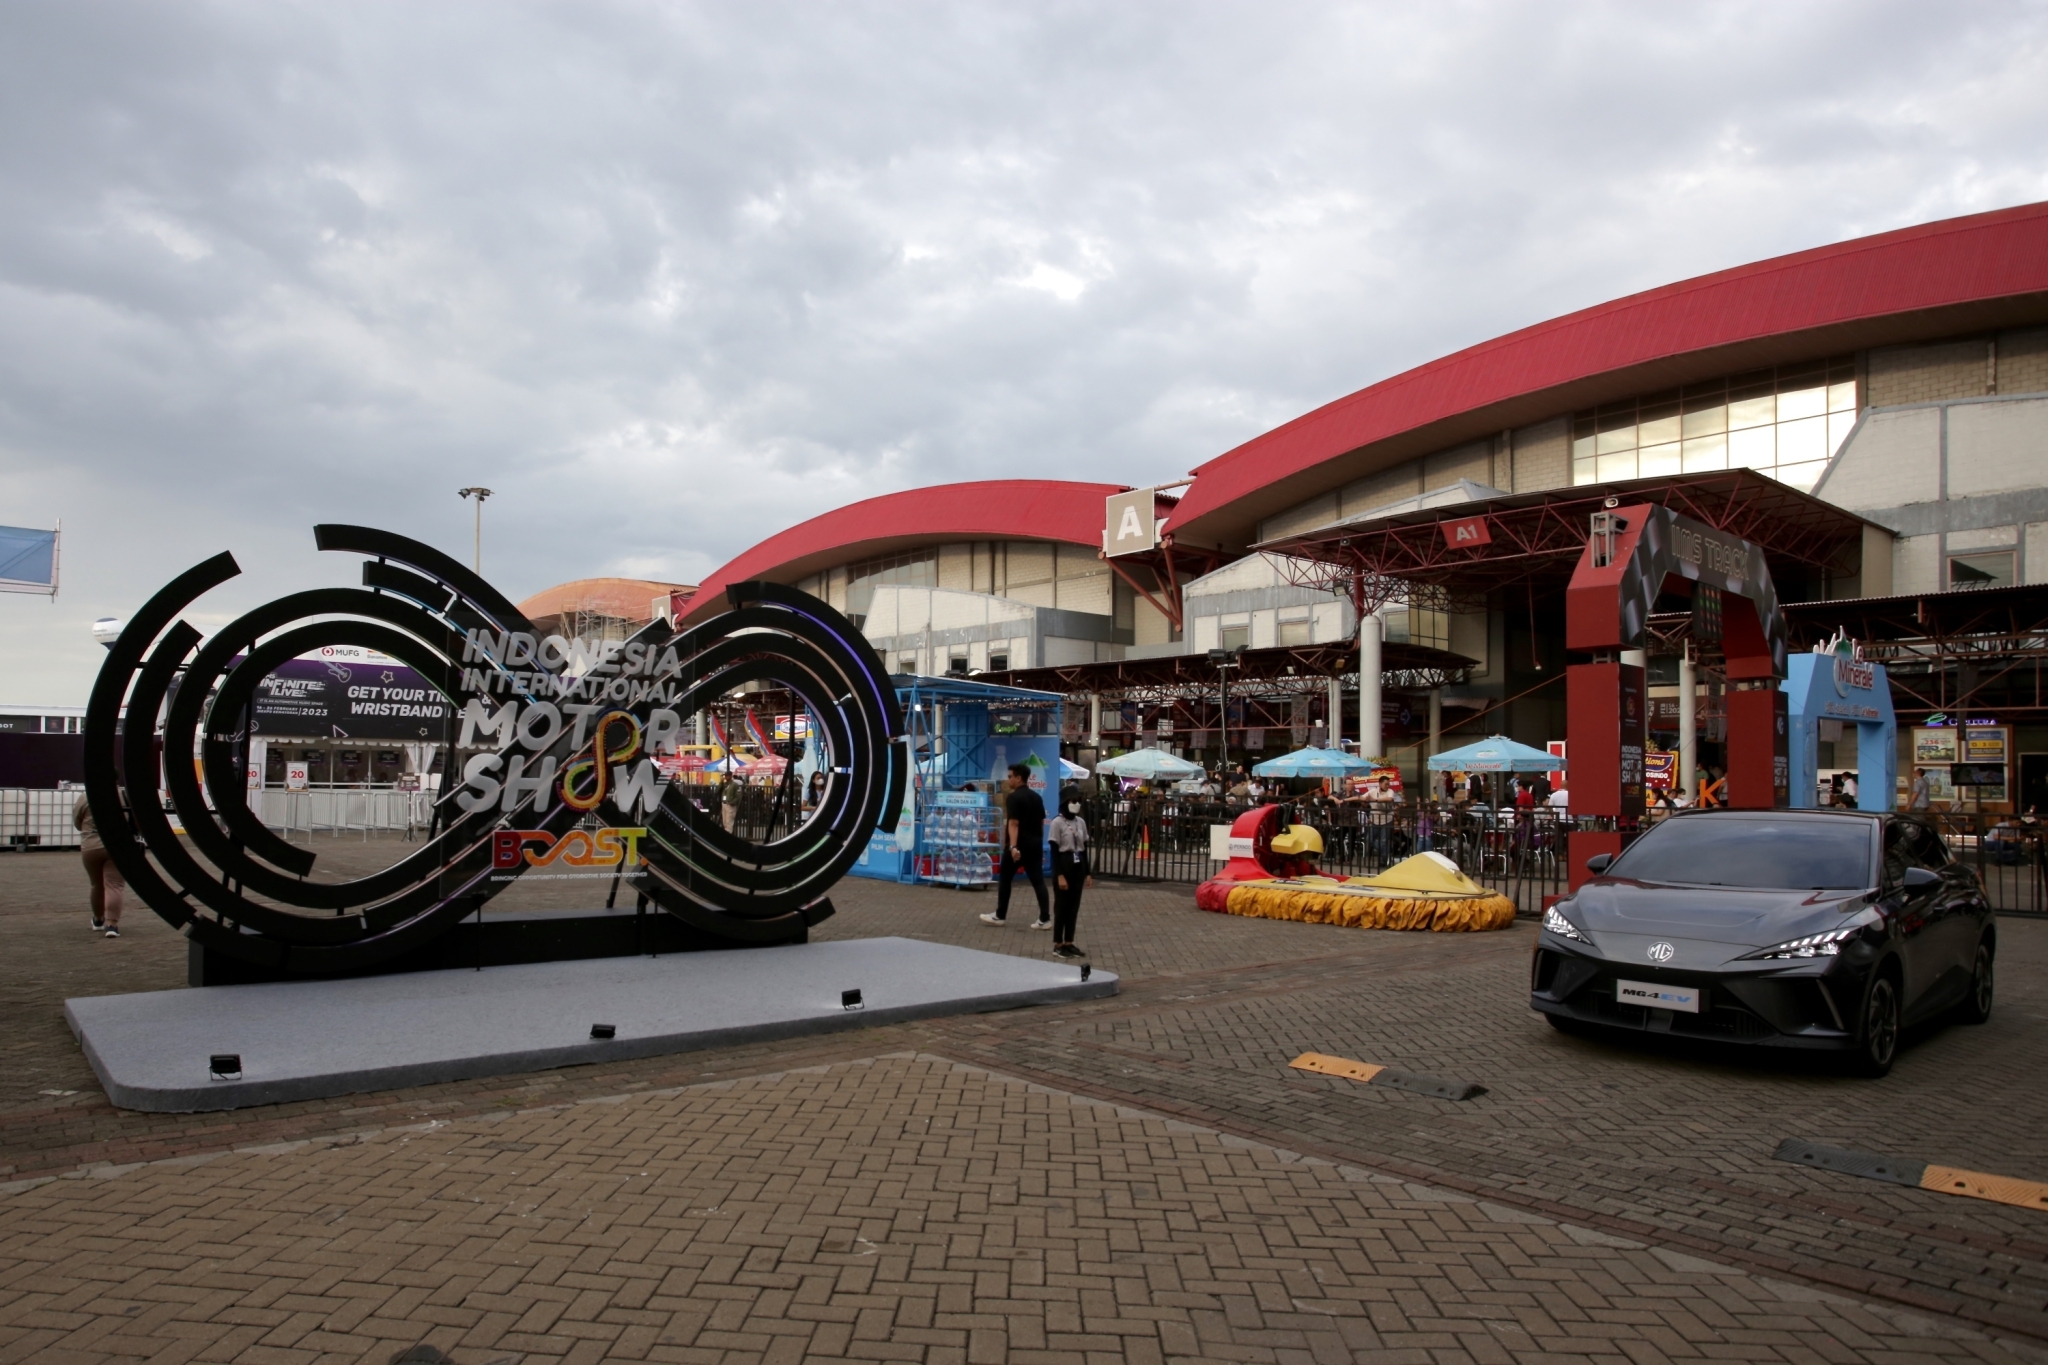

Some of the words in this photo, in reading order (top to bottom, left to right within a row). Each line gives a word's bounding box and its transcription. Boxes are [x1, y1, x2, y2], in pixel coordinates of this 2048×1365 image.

[1117, 505, 1143, 540] A
[1455, 524, 1478, 541] A1
[1671, 524, 1702, 565] IIMS
[1704, 537, 1749, 580] TRACK
[335, 649, 360, 657] MUFG
[462, 628, 683, 679] INDONESIA
[1852, 638, 1864, 666] Le
[347, 685, 380, 699] GET
[382, 687, 426, 702] YOUR
[460, 667, 682, 703] INTERNATIONAL
[301, 708, 328, 716] 2023
[350, 702, 443, 718] WRISTBAND
[458, 698, 682, 754] MOTOR
[291, 770, 304, 779] 20
[455, 753, 669, 814] SHOW
[1027, 780, 1047, 789] nerale
[1699, 778, 1726, 809] K
[1649, 943, 1672, 960] MG
